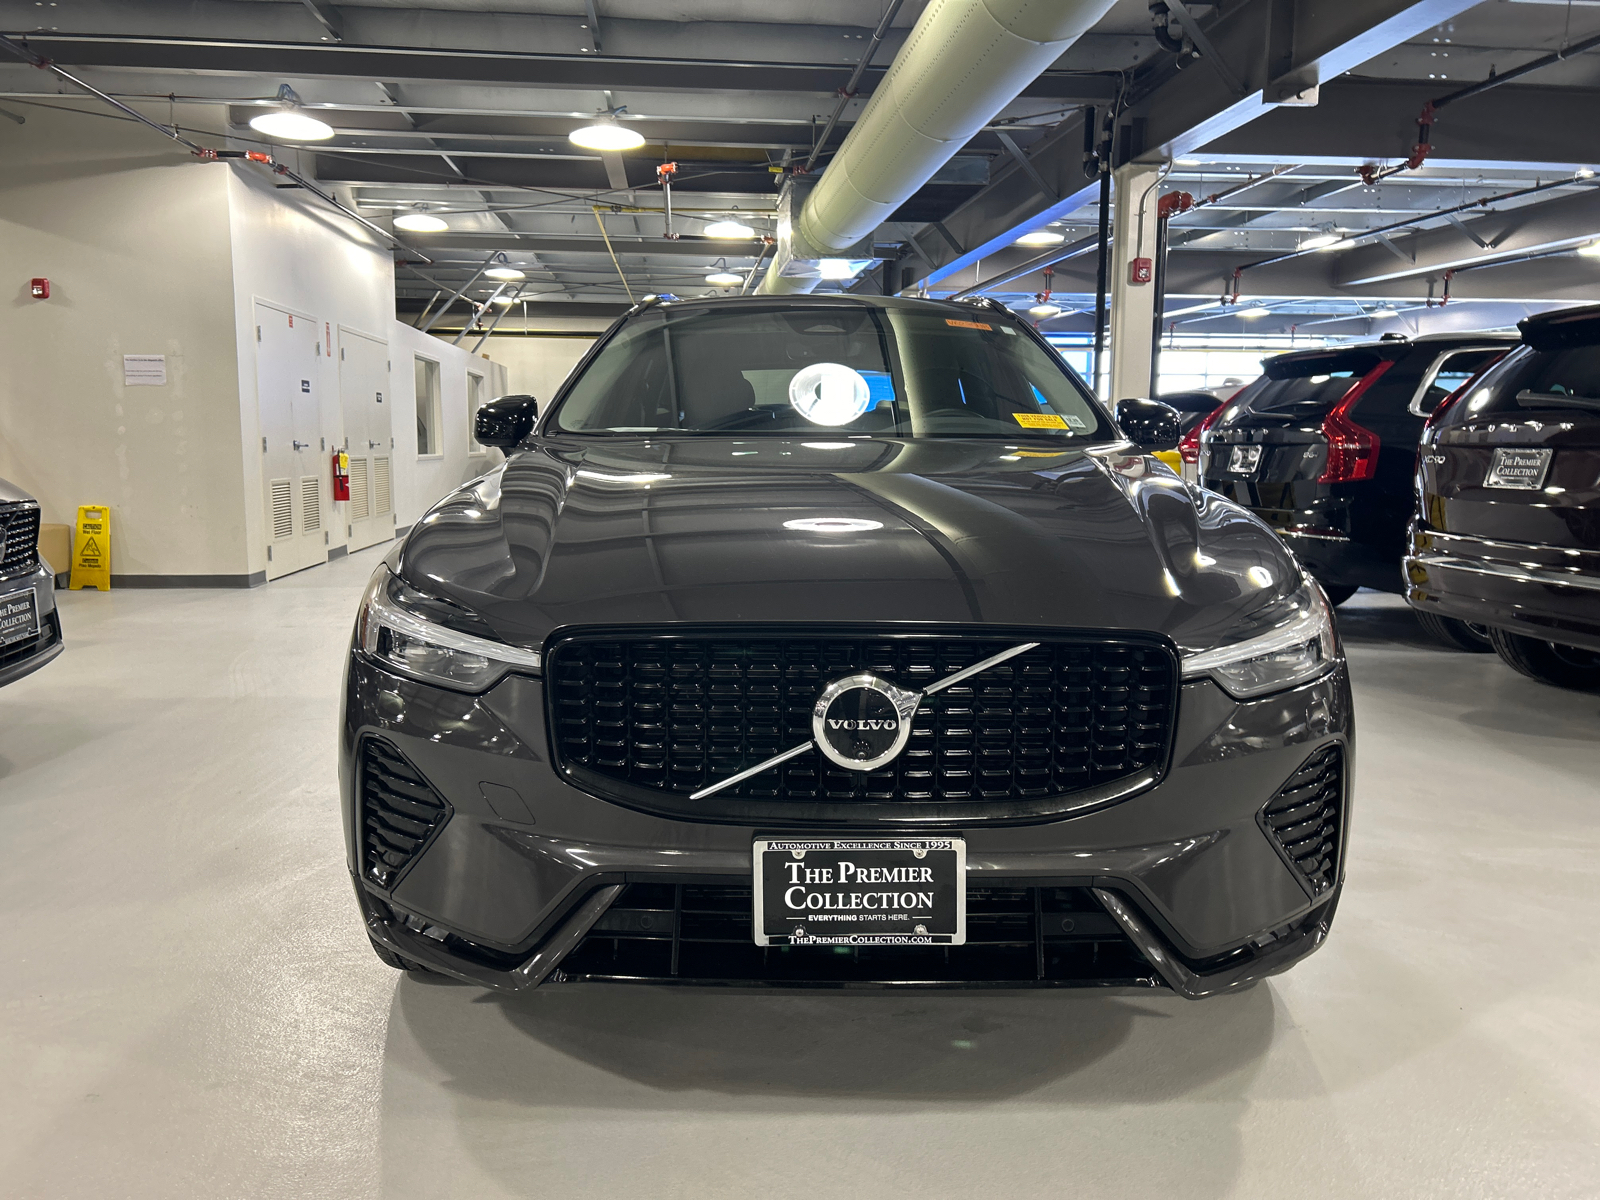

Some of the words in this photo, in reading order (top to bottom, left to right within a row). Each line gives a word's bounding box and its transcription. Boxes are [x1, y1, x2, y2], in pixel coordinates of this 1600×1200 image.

[1500, 456, 1513, 466] THE
[1514, 456, 1541, 467] PREMIER
[1496, 465, 1539, 477] COLLECTION
[0, 607, 8, 618] HE
[7, 601, 30, 615] PREMIER
[0, 611, 32, 629] OLLECTION
[827, 719, 897, 730] VOLVO
[769, 841, 831, 850] AUTOMOTIVE
[833, 841, 892, 850] EXCELLENCE
[893, 841, 923, 849] SINCE
[925, 841, 950, 849] 1995
[784, 861, 834, 884] THE
[837, 861, 934, 883] PREMIER
[784, 886, 934, 909] COLLECTION
[808, 914, 857, 922] EVERYTHING
